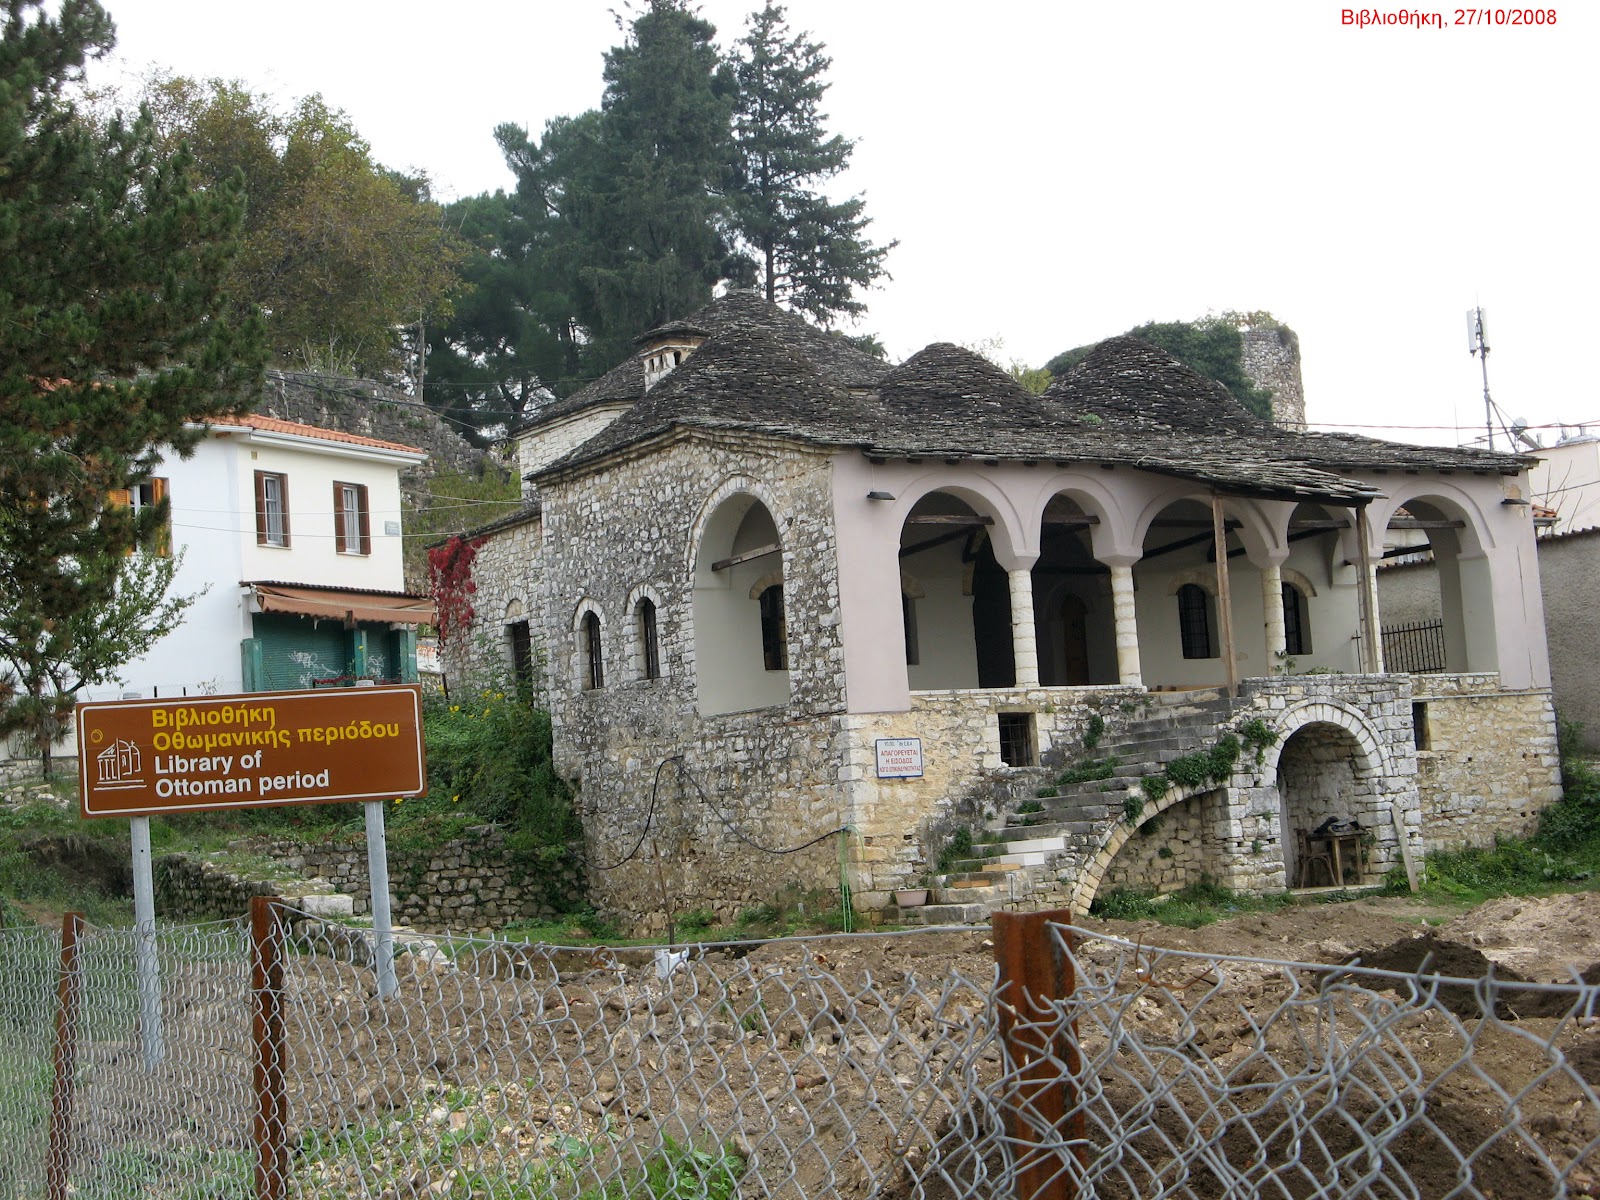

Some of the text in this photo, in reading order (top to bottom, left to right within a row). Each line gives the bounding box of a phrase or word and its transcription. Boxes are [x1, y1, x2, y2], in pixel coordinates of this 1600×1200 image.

[152, 705, 276, 731] Βιβλιοθήκη
[152, 720, 400, 753] Οθωμανικής περιόδου
[154, 749, 262, 775] Library of
[155, 768, 330, 798] Ottoman period
